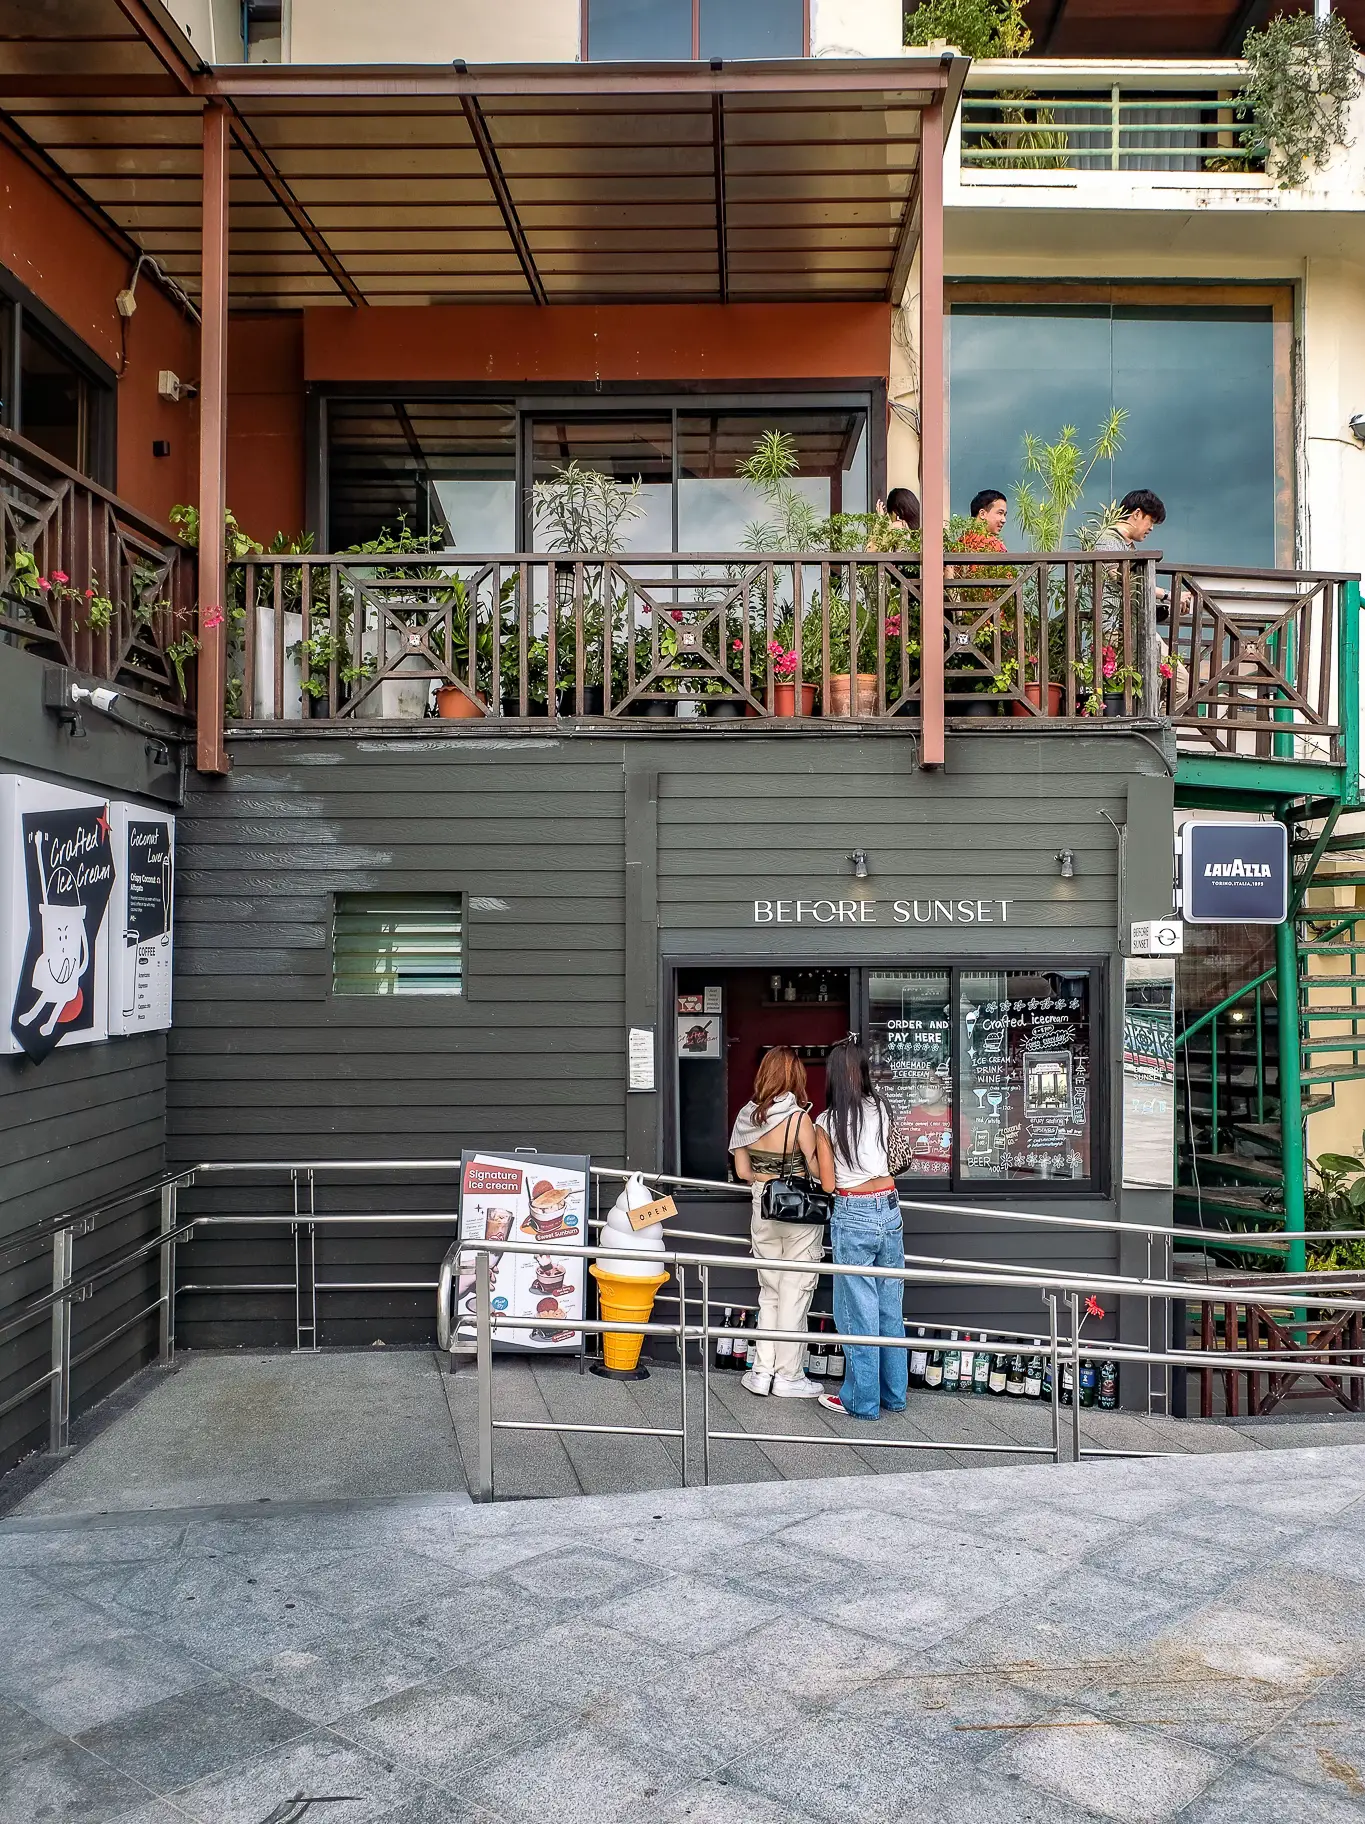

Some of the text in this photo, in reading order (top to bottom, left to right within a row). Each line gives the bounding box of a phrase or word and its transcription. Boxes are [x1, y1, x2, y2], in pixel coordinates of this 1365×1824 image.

[130, 827, 160, 847] Coconut
[50, 824, 99, 868] Crafted
[147, 848, 163, 863] Lover
[1203, 858, 1272, 878] LAVAZZA
[56, 862, 110, 894] Ice Cream
[754, 900, 1014, 922] BEFORE SUNSET
[1133, 926, 1149, 938] BEFORE
[1133, 938, 1149, 949] SUNSET
[138, 946, 156, 957] COFFEE
[887, 1019, 949, 1030] ORDER AND
[982, 1012, 1069, 1031] Crafted icecream
[888, 1032, 942, 1043] PAY HERE
[890, 1061, 931, 1070] HOMEMADE
[972, 1056, 1011, 1067] ICE CREAM
[892, 1070, 930, 1078] ICECREAM
[976, 1066, 1003, 1074] DRINK
[977, 1075, 1001, 1083] WINE
[967, 1156, 991, 1168] BEER
[469, 1169, 518, 1181] Signature
[468, 1180, 519, 1191] Ice cream
[639, 1205, 668, 1221] OPEN
